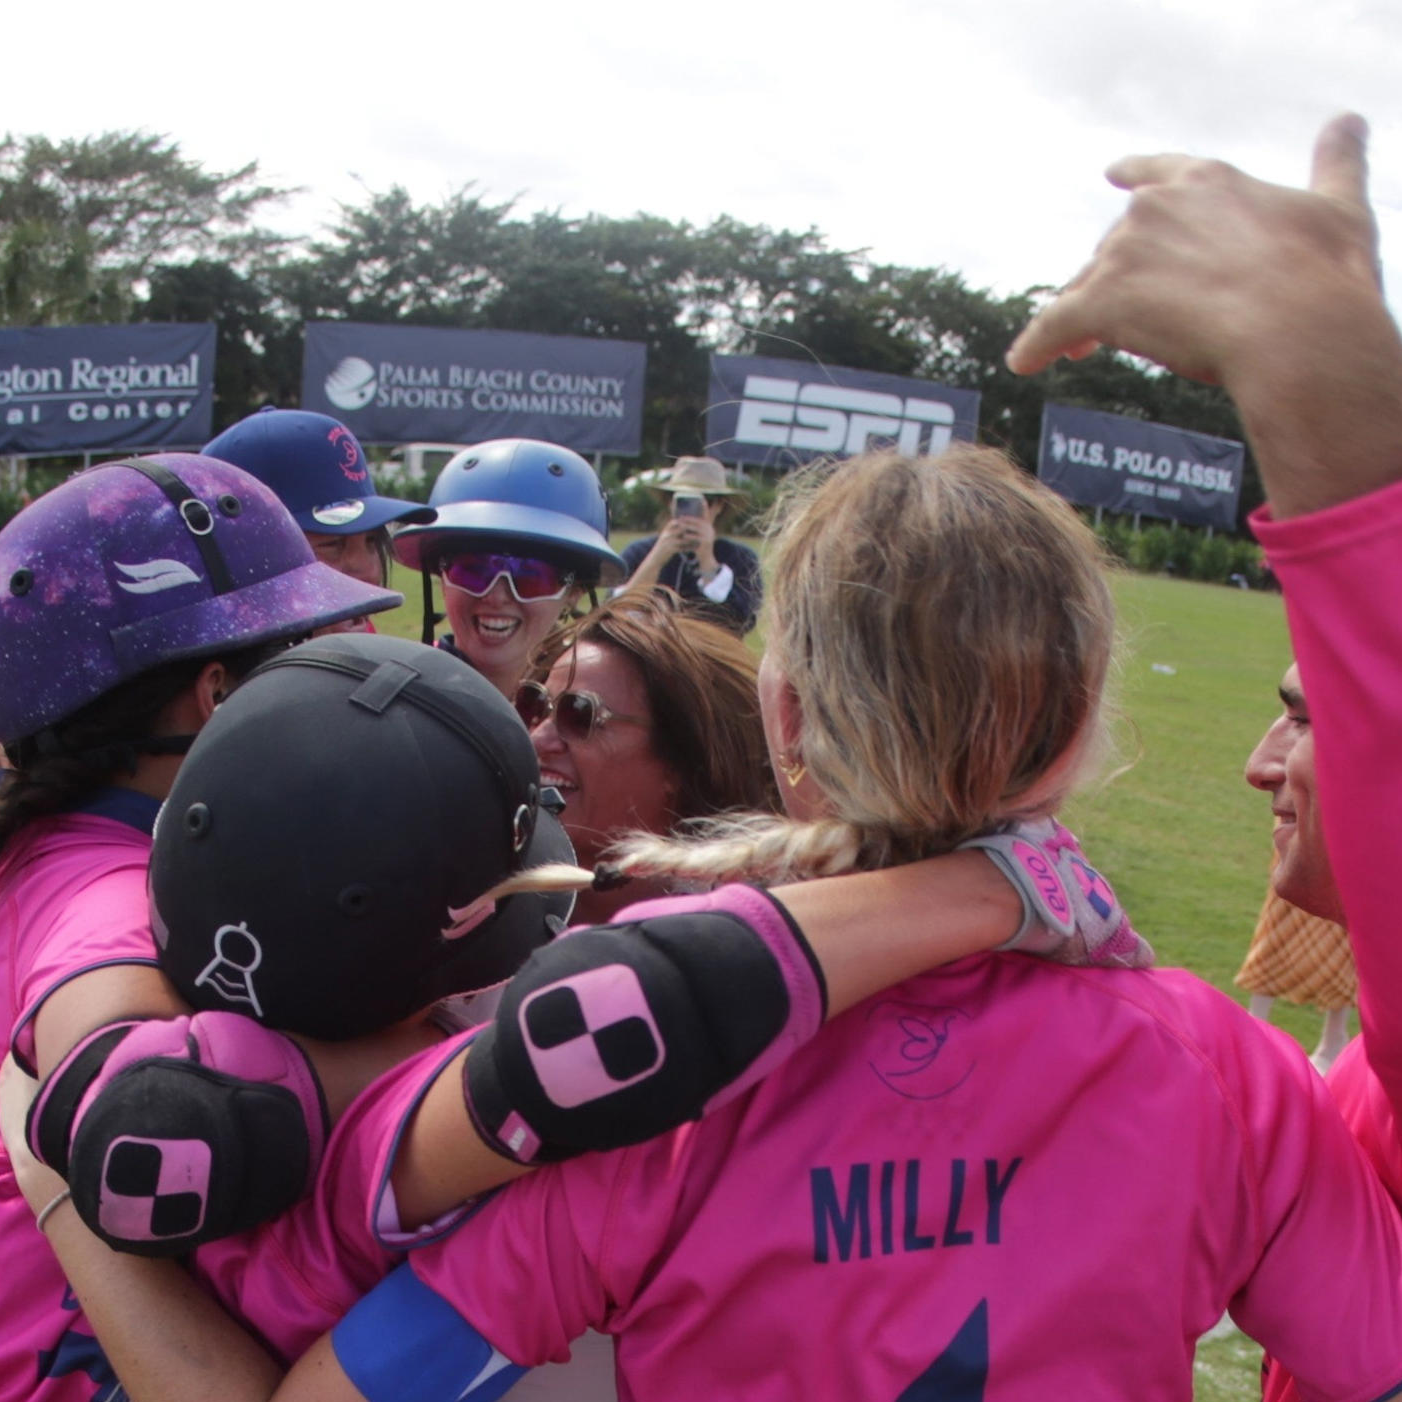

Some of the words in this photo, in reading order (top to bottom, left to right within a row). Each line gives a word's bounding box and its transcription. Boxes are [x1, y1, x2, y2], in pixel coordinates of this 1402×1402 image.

[69, 353, 199, 398] Regional
[378, 362, 440, 386] PALM
[449, 365, 524, 391] BEACH
[530, 369, 624, 398] COUNTY
[67, 400, 192, 421] Center
[376, 384, 466, 410] SPORTS
[471, 388, 625, 418] COMMISSION
[734, 375, 956, 459] ESPN
[1068, 437, 1108, 467] U.S.
[1112, 446, 1173, 479] POLO
[1174, 460, 1235, 493] ASSN.
[810, 1156, 1023, 1264] MILLY
